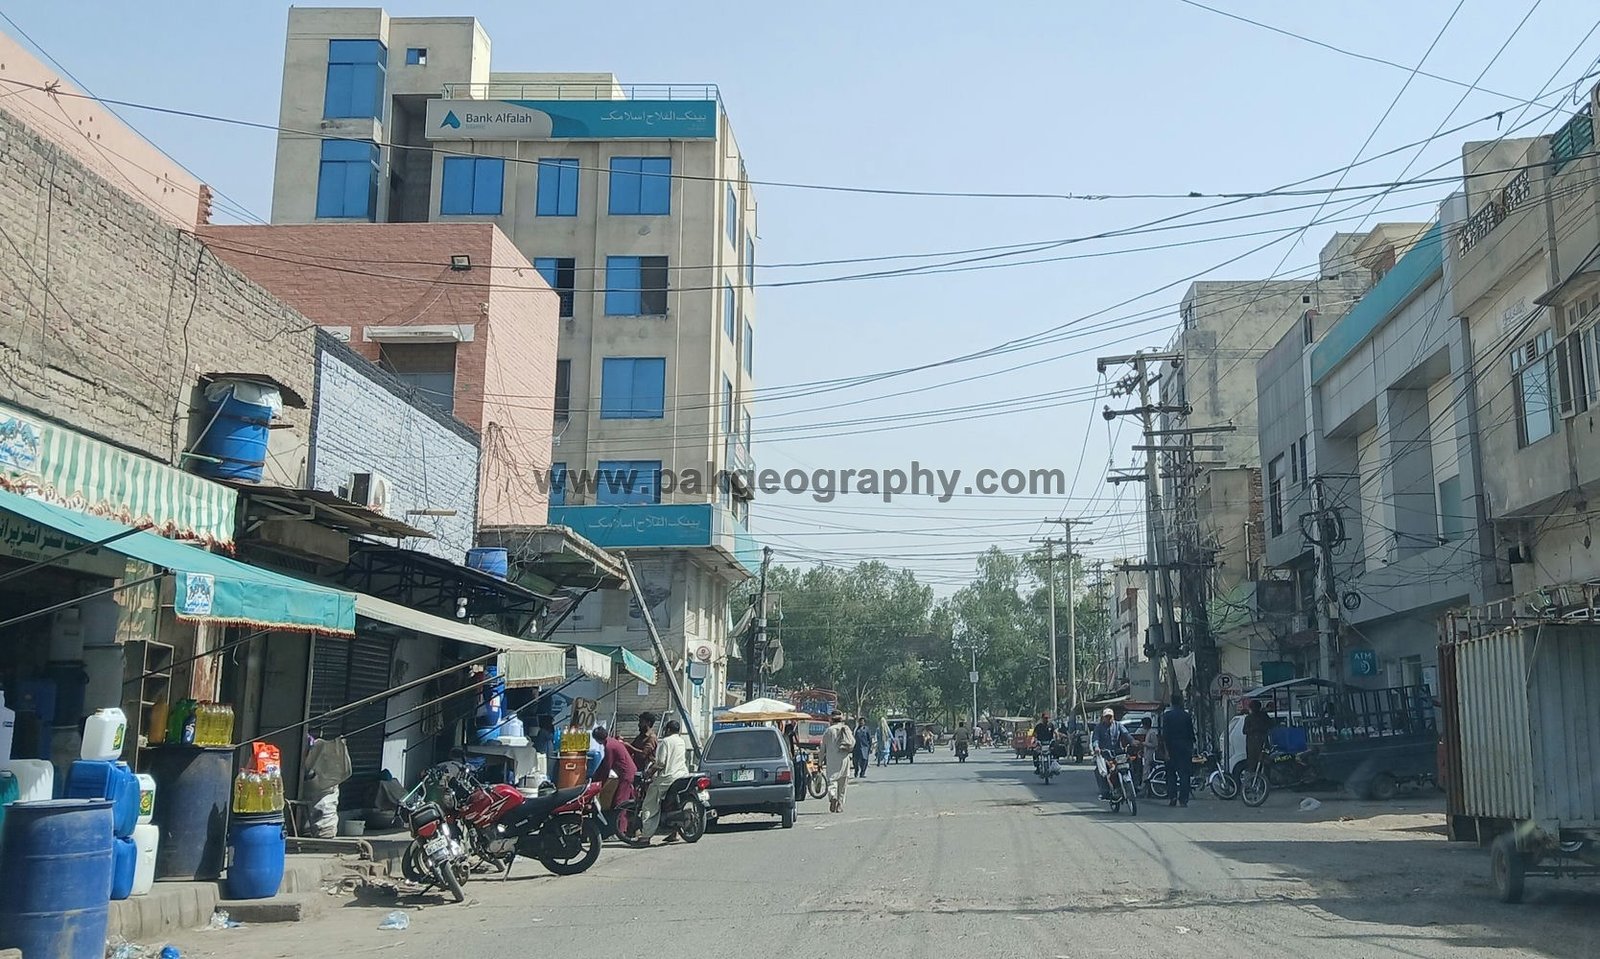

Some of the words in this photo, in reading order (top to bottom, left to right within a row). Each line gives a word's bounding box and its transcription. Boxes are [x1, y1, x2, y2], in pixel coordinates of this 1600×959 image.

[466, 113, 493, 123] Bank
[495, 112, 532, 123] Alfalah
[1354, 652, 1372, 660] ATM
[1221, 676, 1230, 687] P
